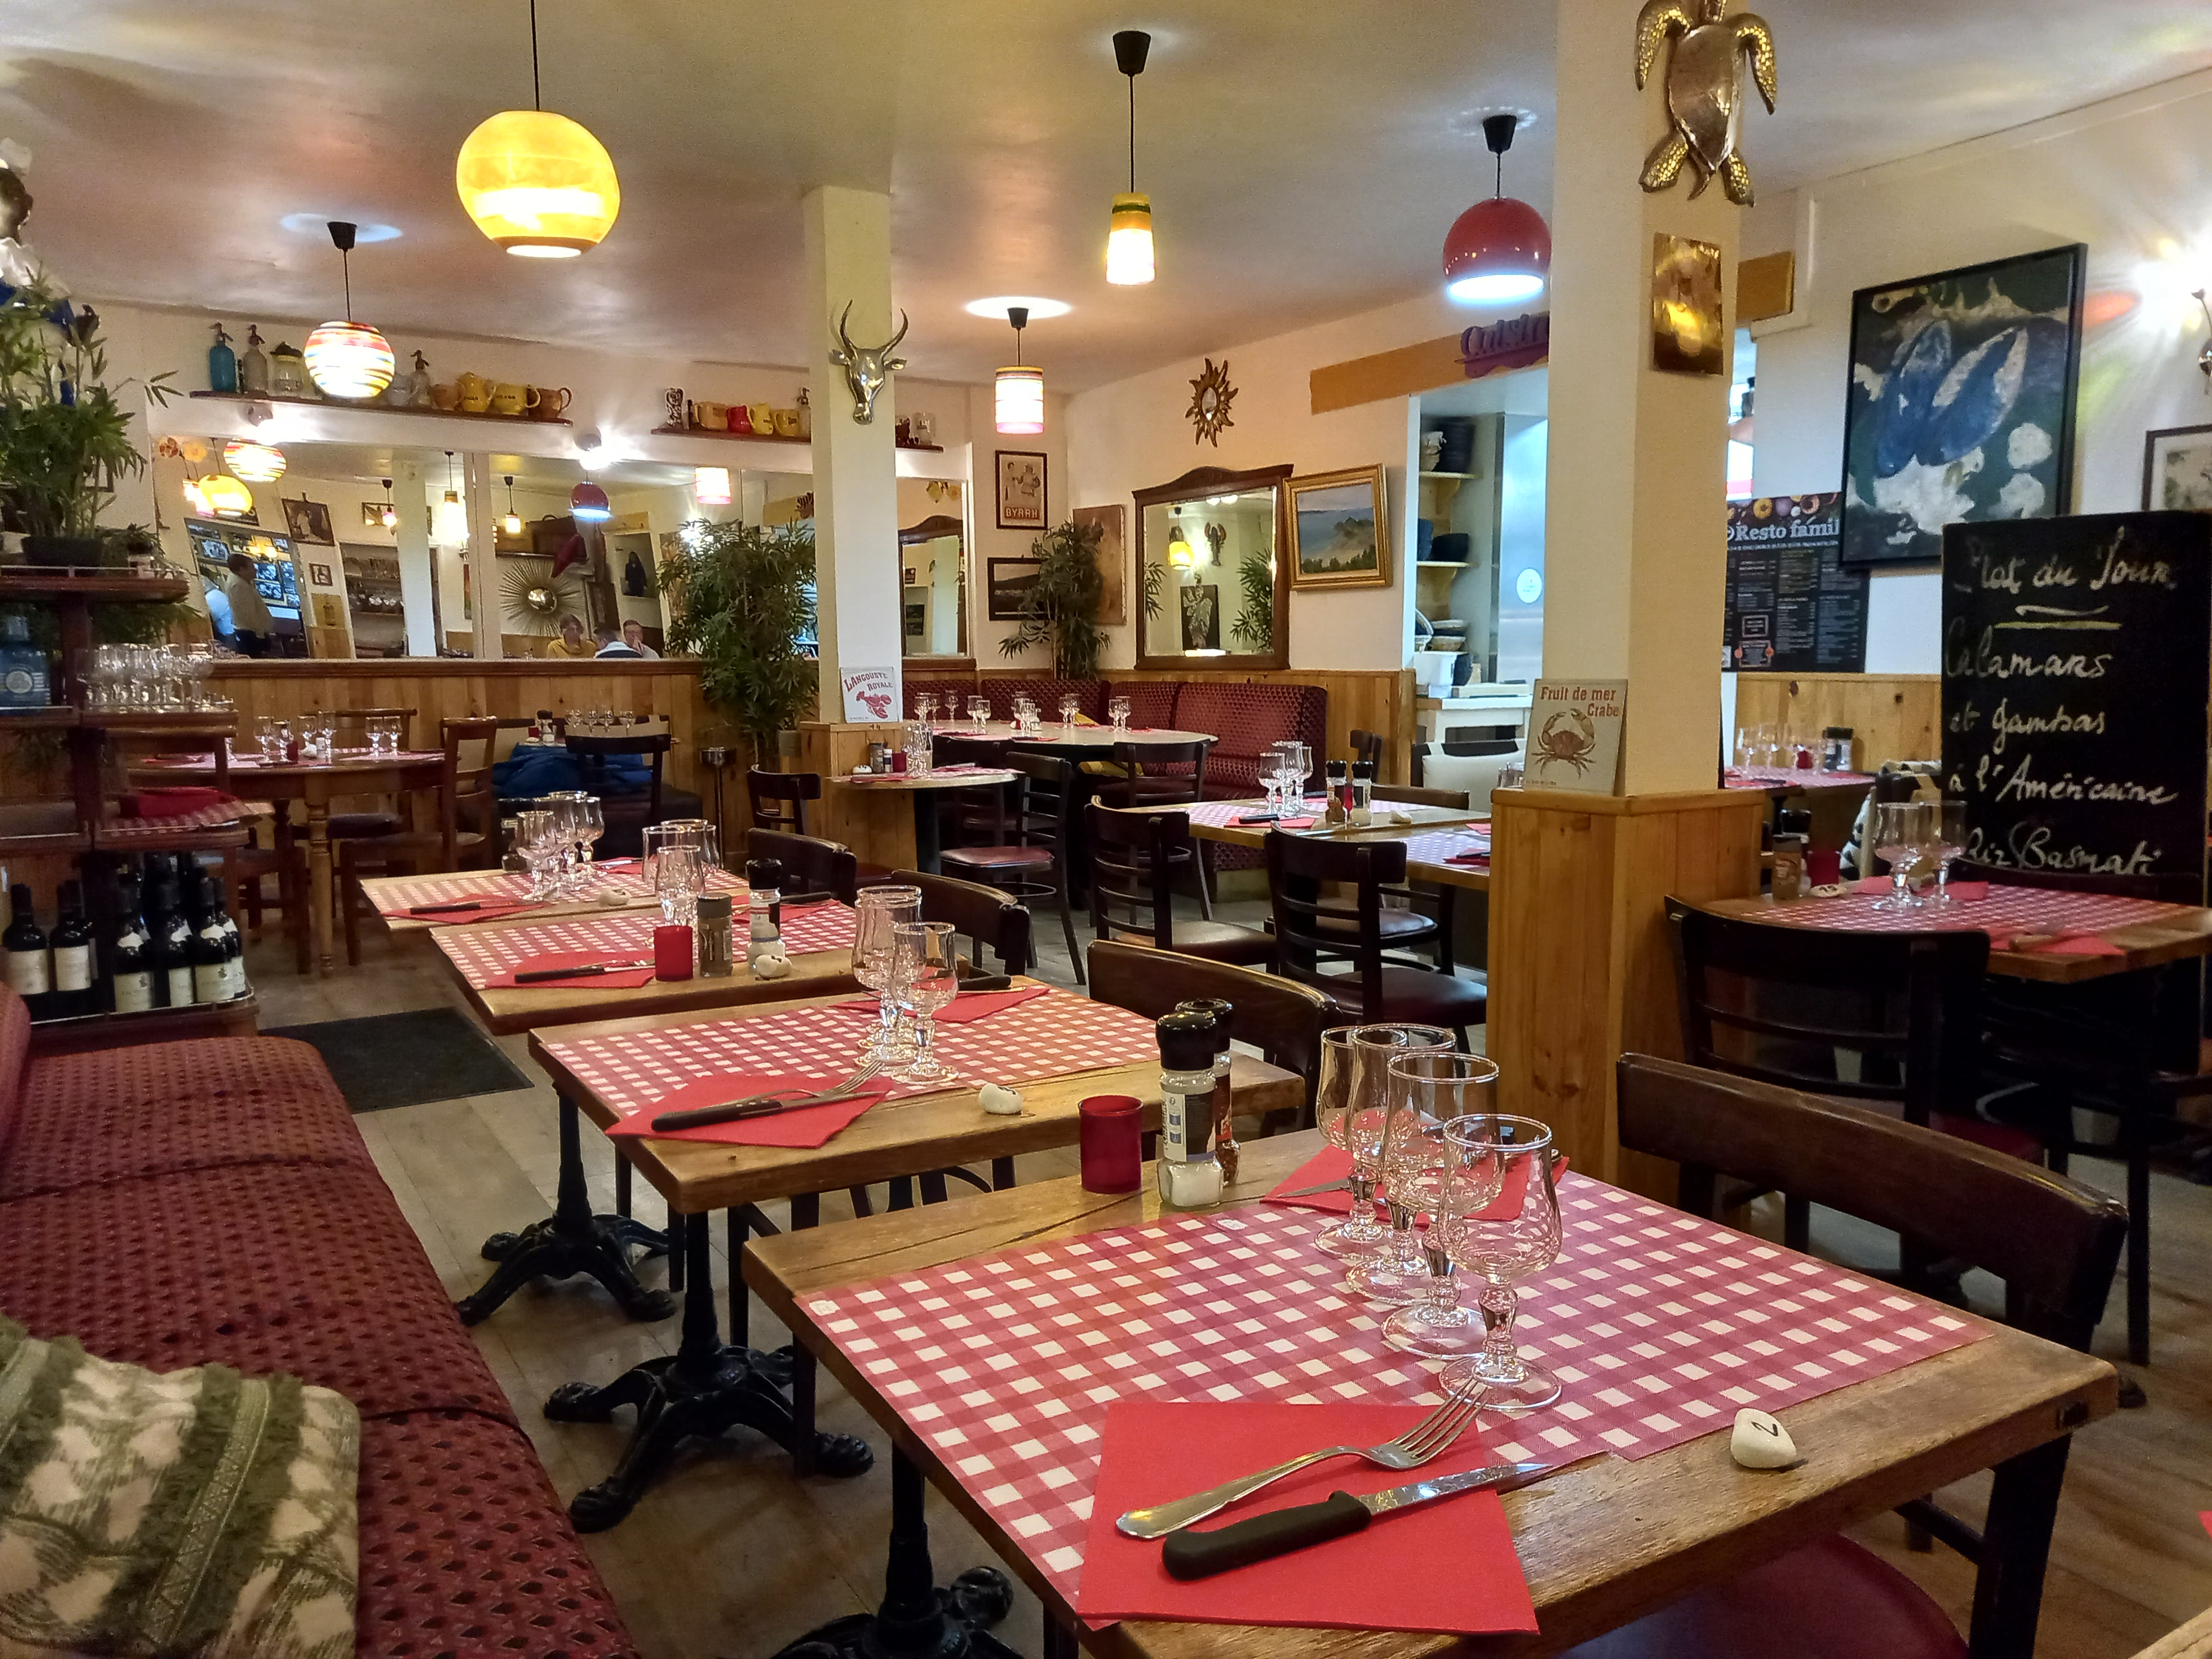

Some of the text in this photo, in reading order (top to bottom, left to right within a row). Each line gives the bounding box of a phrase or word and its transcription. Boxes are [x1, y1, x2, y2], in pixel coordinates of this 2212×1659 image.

[1006, 508, 1038, 518] BYRRH
[1735, 519, 1840, 542] Resto famil
[2032, 555, 2078, 589] du
[843, 672, 888, 692] LANGOUSTE
[867, 682, 893, 691] ROYALE
[1541, 686, 1616, 701] Fruit de mer
[1587, 703, 1620, 717] Crabe
